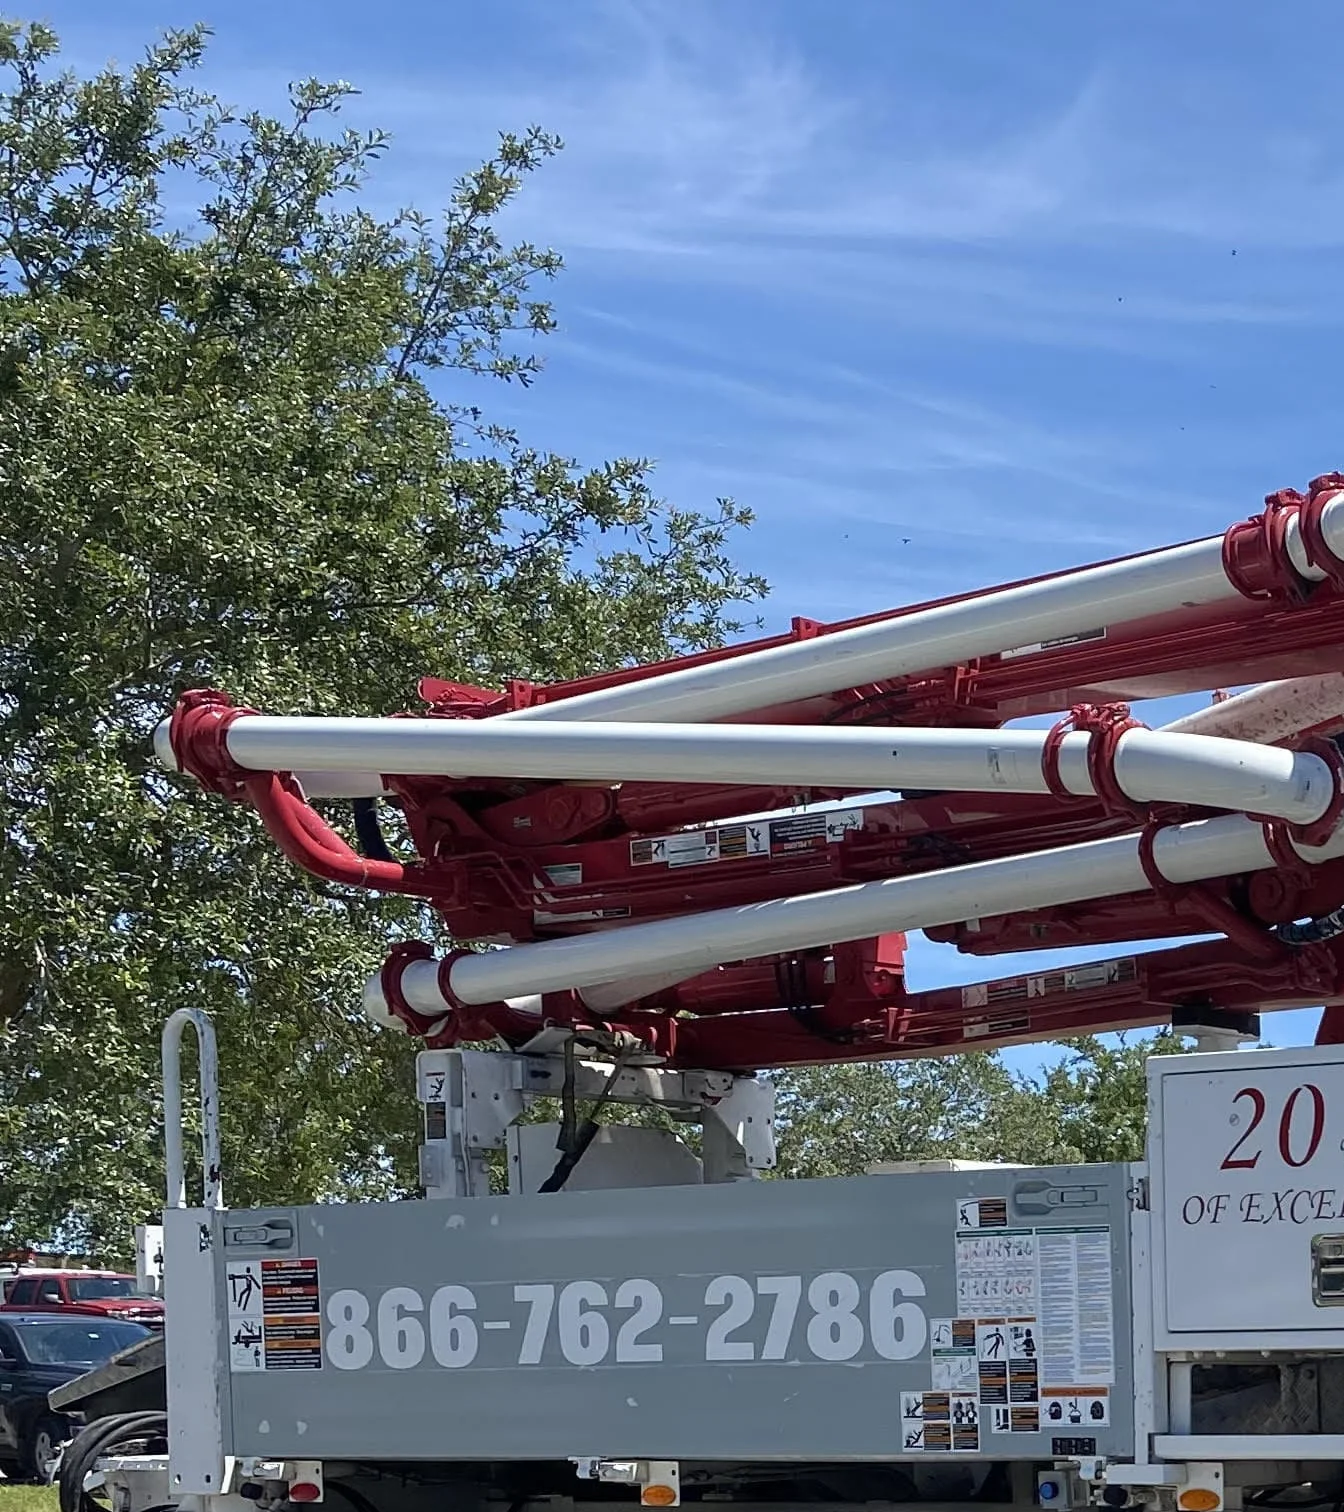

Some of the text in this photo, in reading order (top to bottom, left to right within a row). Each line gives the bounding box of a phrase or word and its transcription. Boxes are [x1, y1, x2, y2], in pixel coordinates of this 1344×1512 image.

[1221, 1083, 1325, 1170] 20
[1182, 1194, 1231, 1225] OF
[325, 1269, 928, 1371] 866-762-2786
